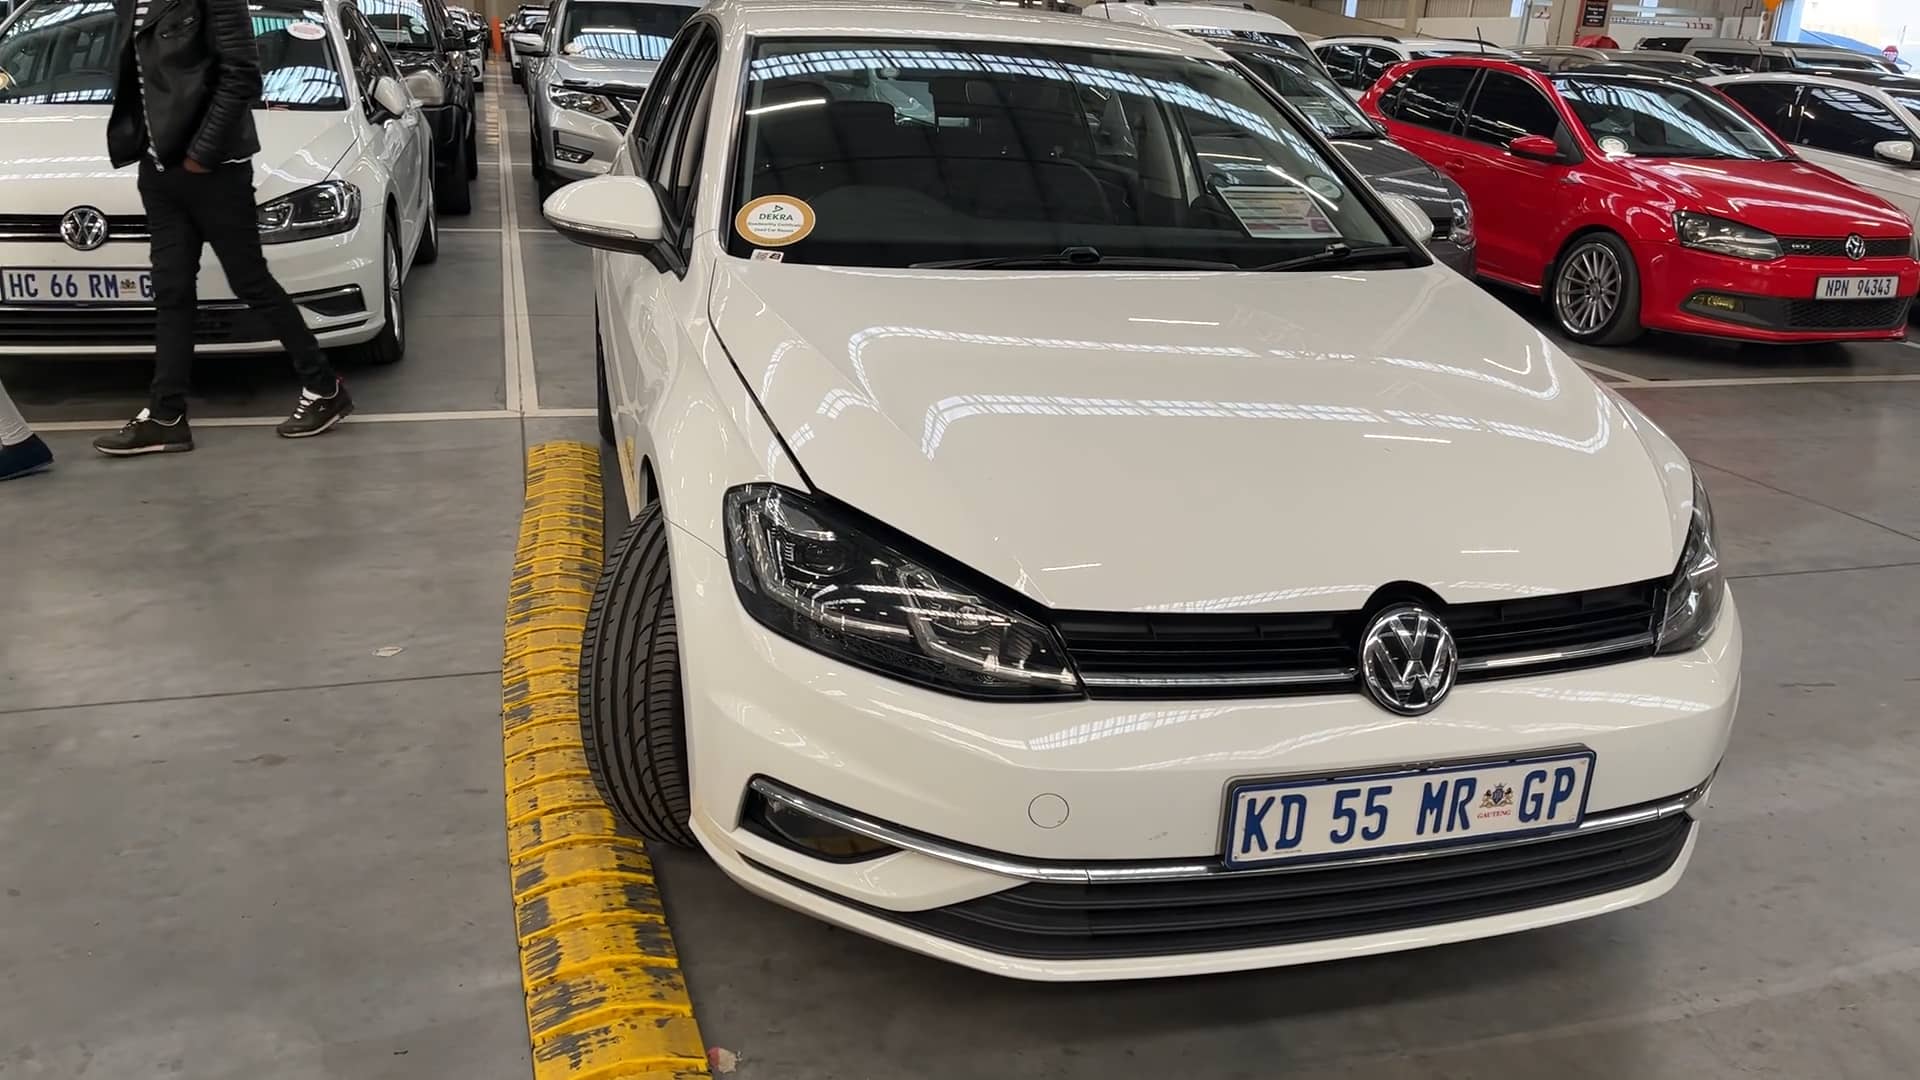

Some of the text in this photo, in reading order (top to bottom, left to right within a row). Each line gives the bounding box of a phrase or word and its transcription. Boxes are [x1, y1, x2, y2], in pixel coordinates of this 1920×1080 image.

[759, 213, 794, 221] DEKRA
[8, 273, 155, 298] HC 66 RM G
[1825, 278, 1892, 297] NPN 94343
[1241, 766, 1576, 854] KD 55 MR GP
[1476, 810, 1512, 819] GAUTENG
